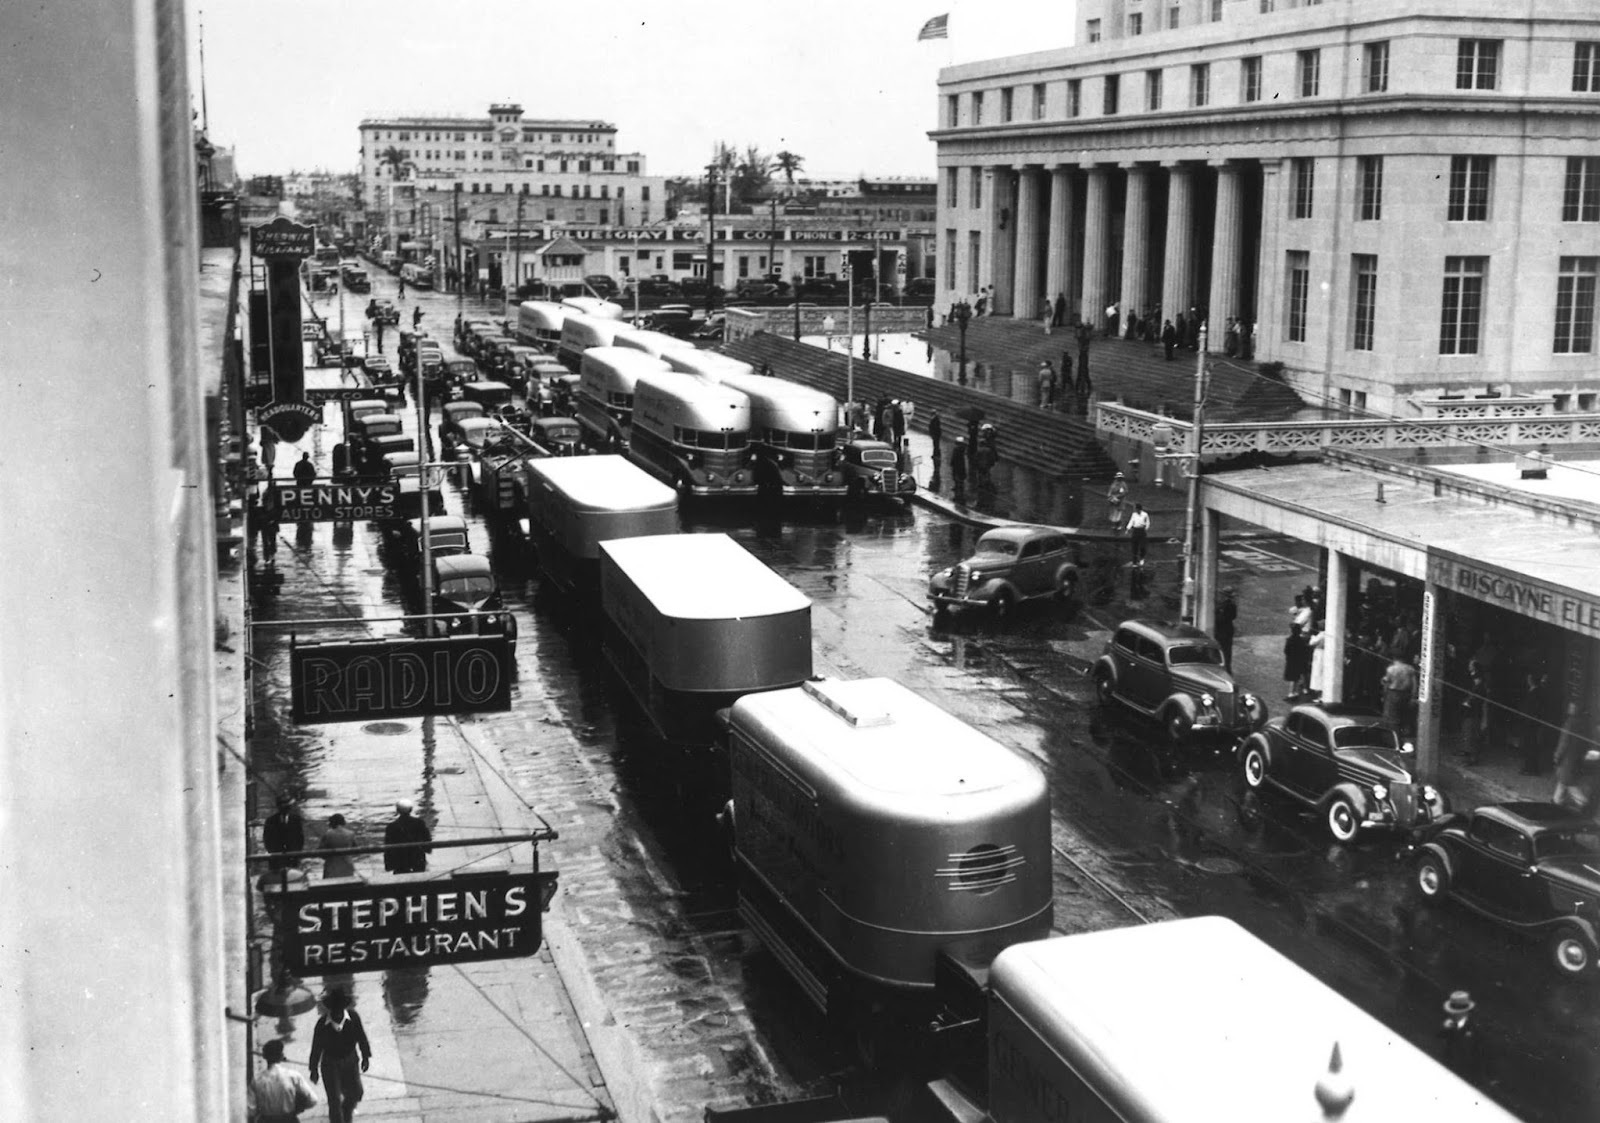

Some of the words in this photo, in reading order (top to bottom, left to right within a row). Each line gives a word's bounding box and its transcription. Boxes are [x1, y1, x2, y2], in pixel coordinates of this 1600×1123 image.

[552, 230, 604, 240] BLUE
[614, 230, 663, 239] GRAY
[743, 231, 773, 240] CO.
[795, 231, 836, 240] PHONE
[841, 254, 849, 278] TAXI
[260, 404, 320, 422] HEADQUARTERS
[281, 486, 395, 506] PENNY'S
[281, 507, 322, 519] AUTO
[334, 505, 394, 518] STORES
[1458, 568, 1553, 615] BISCAYNE
[301, 647, 501, 715] RADIO
[303, 926, 522, 967] RESTAURANT
